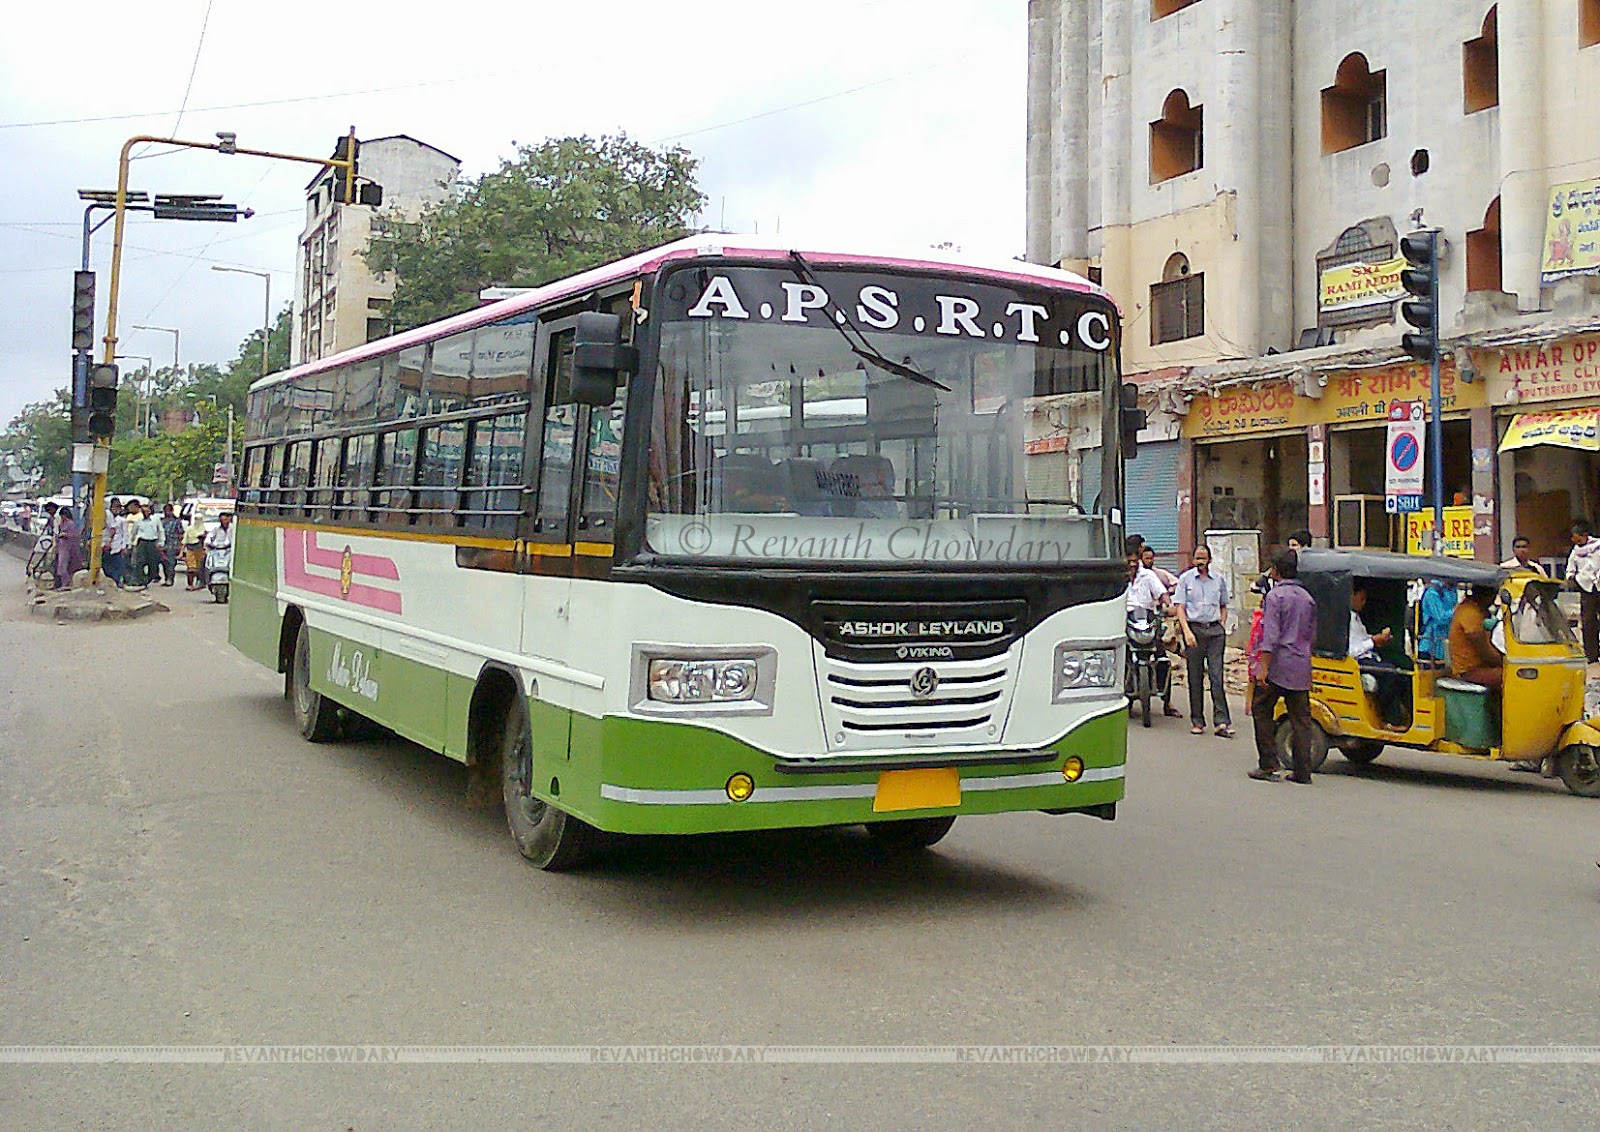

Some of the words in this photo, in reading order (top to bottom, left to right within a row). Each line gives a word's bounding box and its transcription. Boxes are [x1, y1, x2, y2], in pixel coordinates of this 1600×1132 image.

[1327, 280, 1362, 295] RAMI
[1499, 345, 1563, 373] AMAR
[1531, 369, 1562, 384] EYE
[839, 622, 909, 636] ASHOK
[919, 621, 1004, 635] LEYLAND
[909, 646, 953, 658] VIKING
